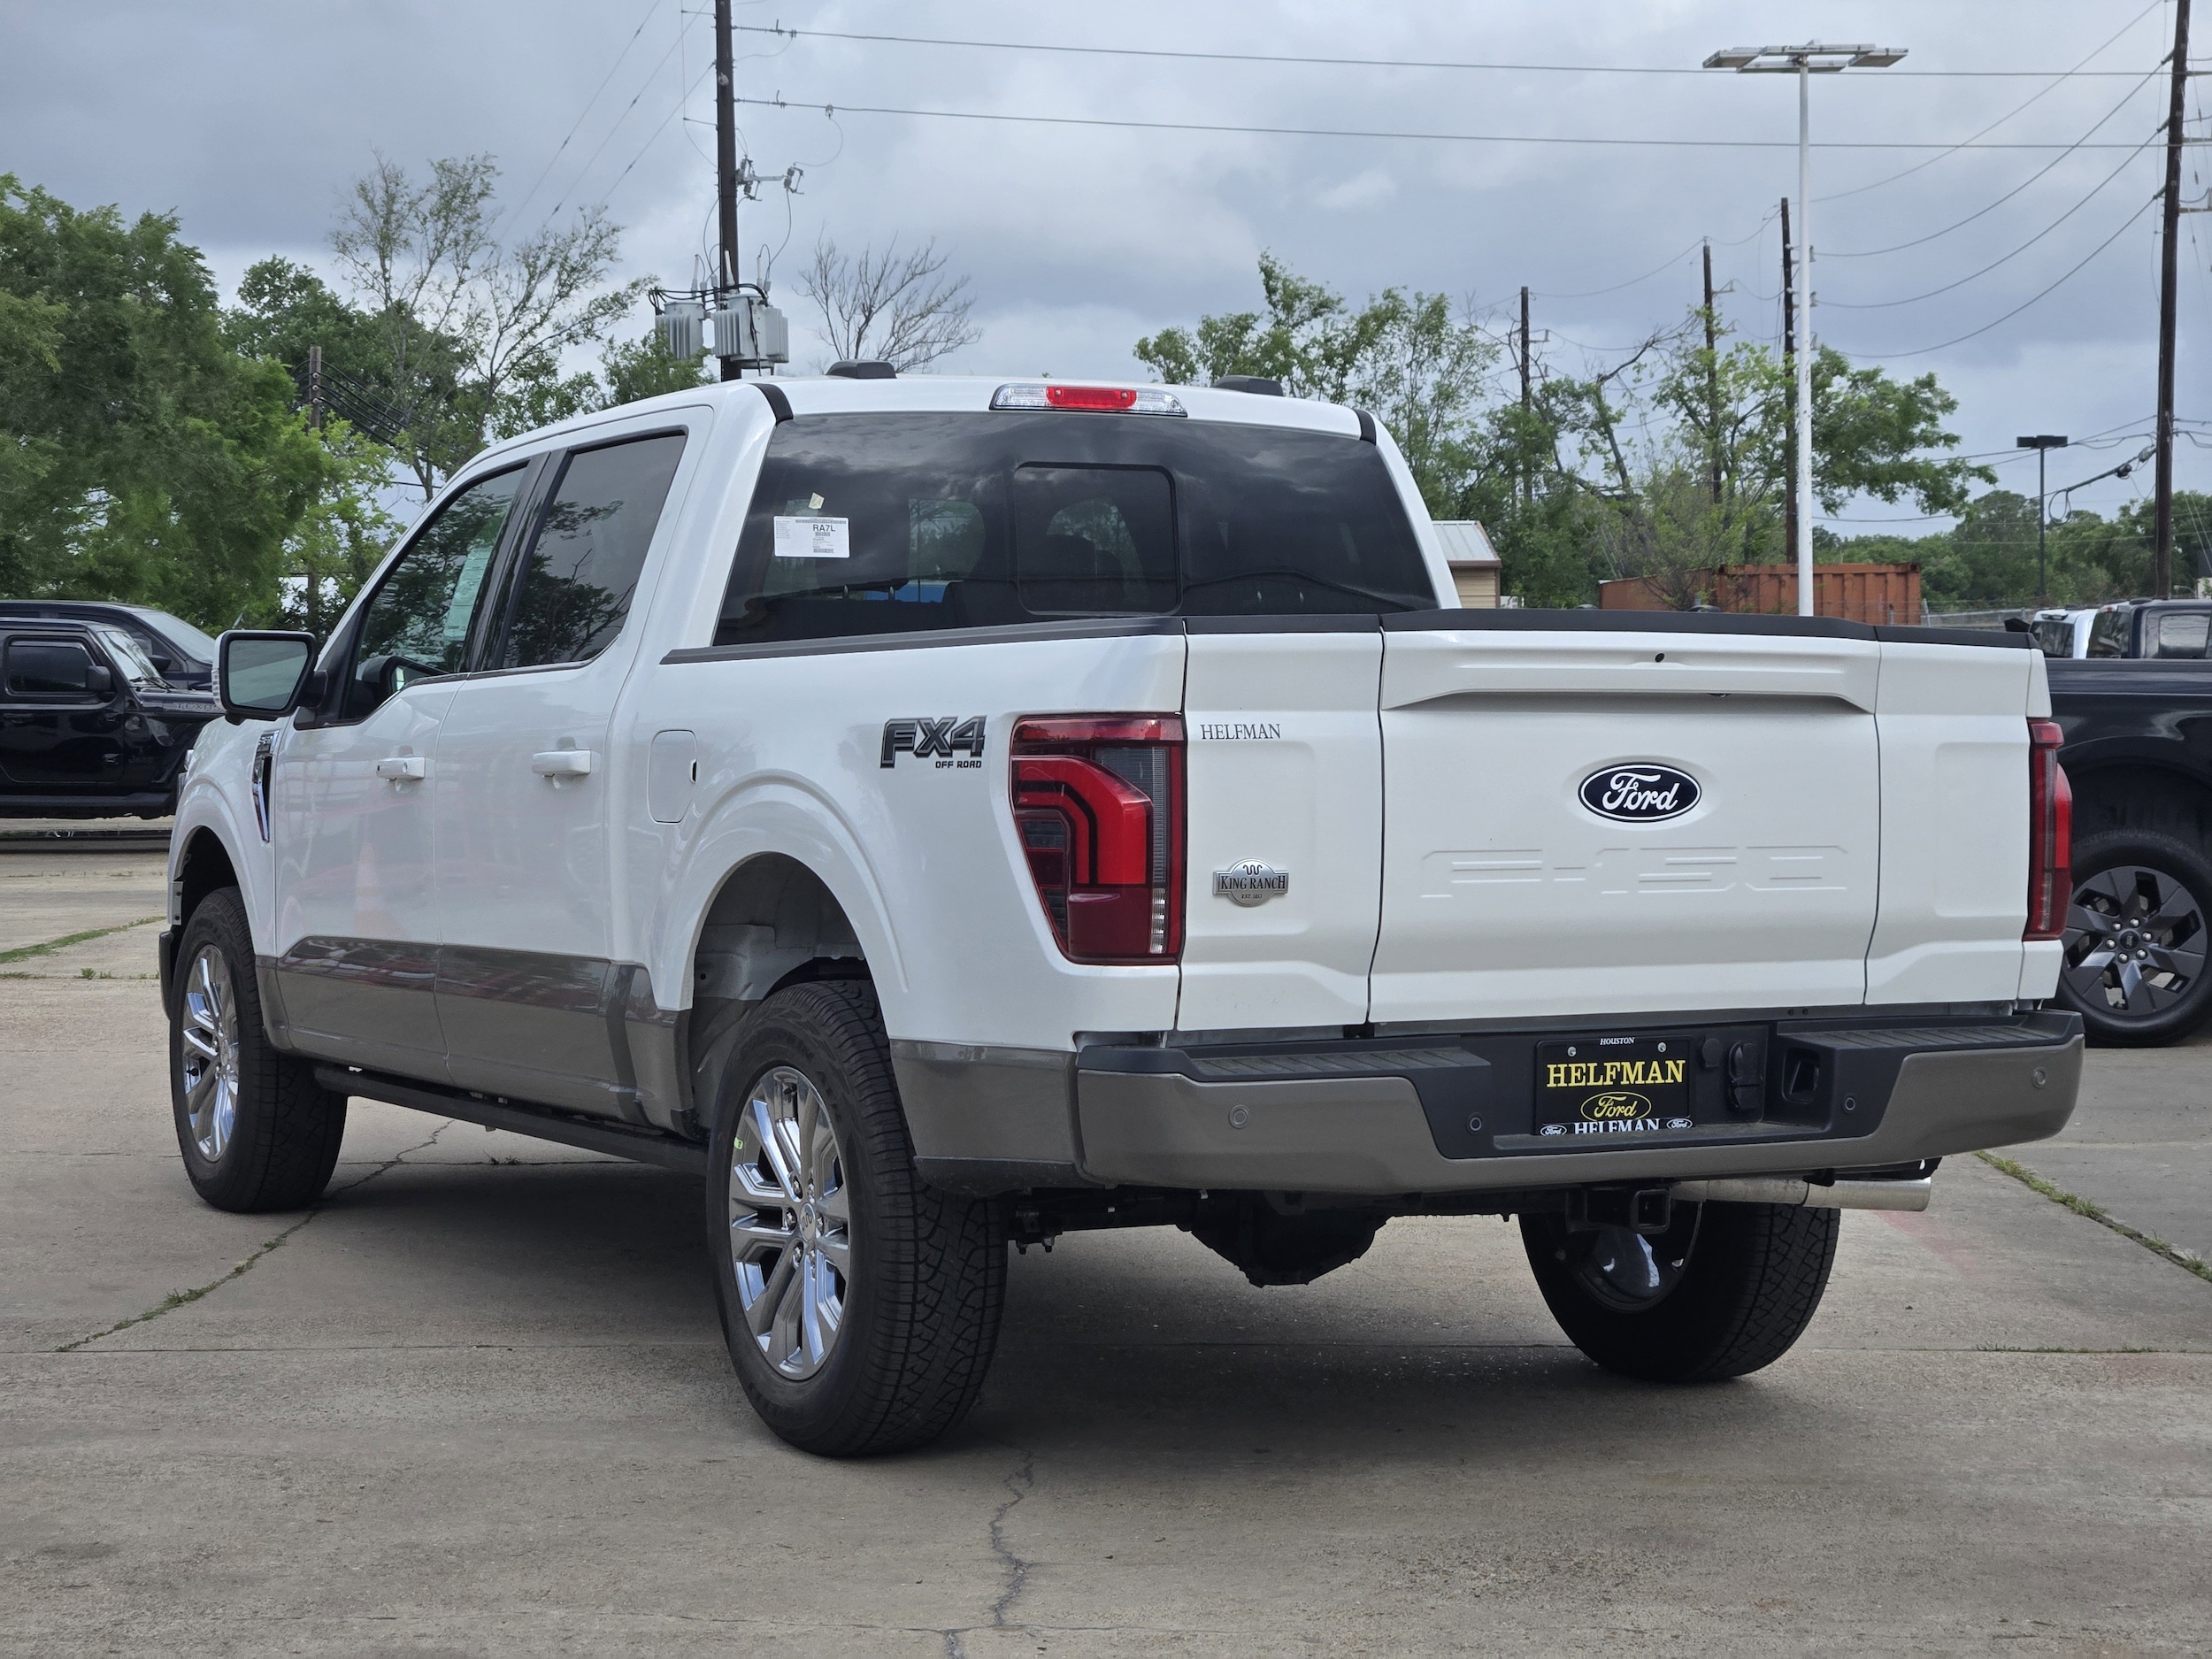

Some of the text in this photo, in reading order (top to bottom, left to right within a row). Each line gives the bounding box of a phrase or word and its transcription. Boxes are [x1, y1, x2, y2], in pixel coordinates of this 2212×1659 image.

[1200, 724, 1281, 740] HELFMAN
[880, 715, 987, 769] FX4
[956, 760, 982, 769] ROAD
[1601, 772, 1680, 810] Ford
[1220, 875, 1286, 890] KING RANCH
[1600, 1037, 1635, 1046] HOUSTON
[1547, 1060, 1686, 1087] HELFMAN
[1594, 1095, 1638, 1118] Ford
[1573, 1118, 1660, 1134] HELFMAN
